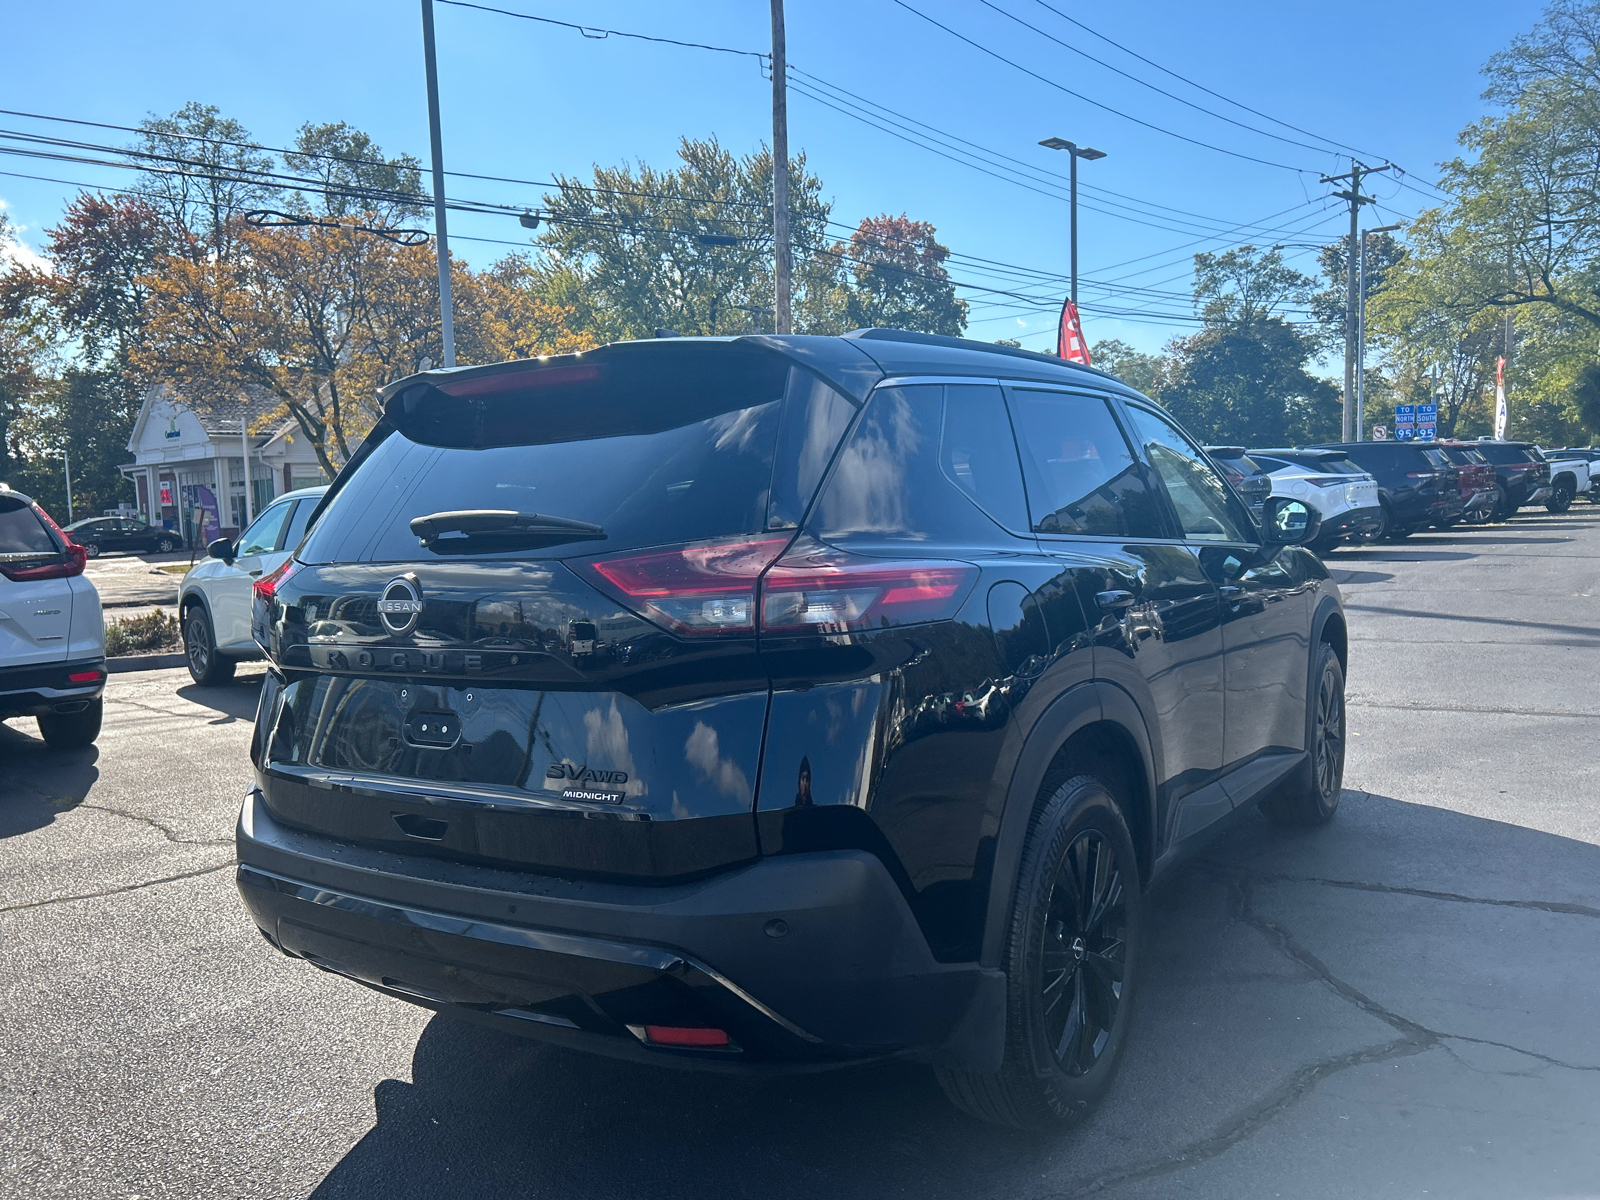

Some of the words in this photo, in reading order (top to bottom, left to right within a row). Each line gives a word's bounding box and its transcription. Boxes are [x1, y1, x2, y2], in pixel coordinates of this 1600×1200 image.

[1398, 429, 1411, 438] 95
[1420, 429, 1434, 437] 95
[378, 603, 421, 611] NISSAN
[326, 650, 483, 671] ROGUE
[562, 790, 619, 801] MIDNIGHT
